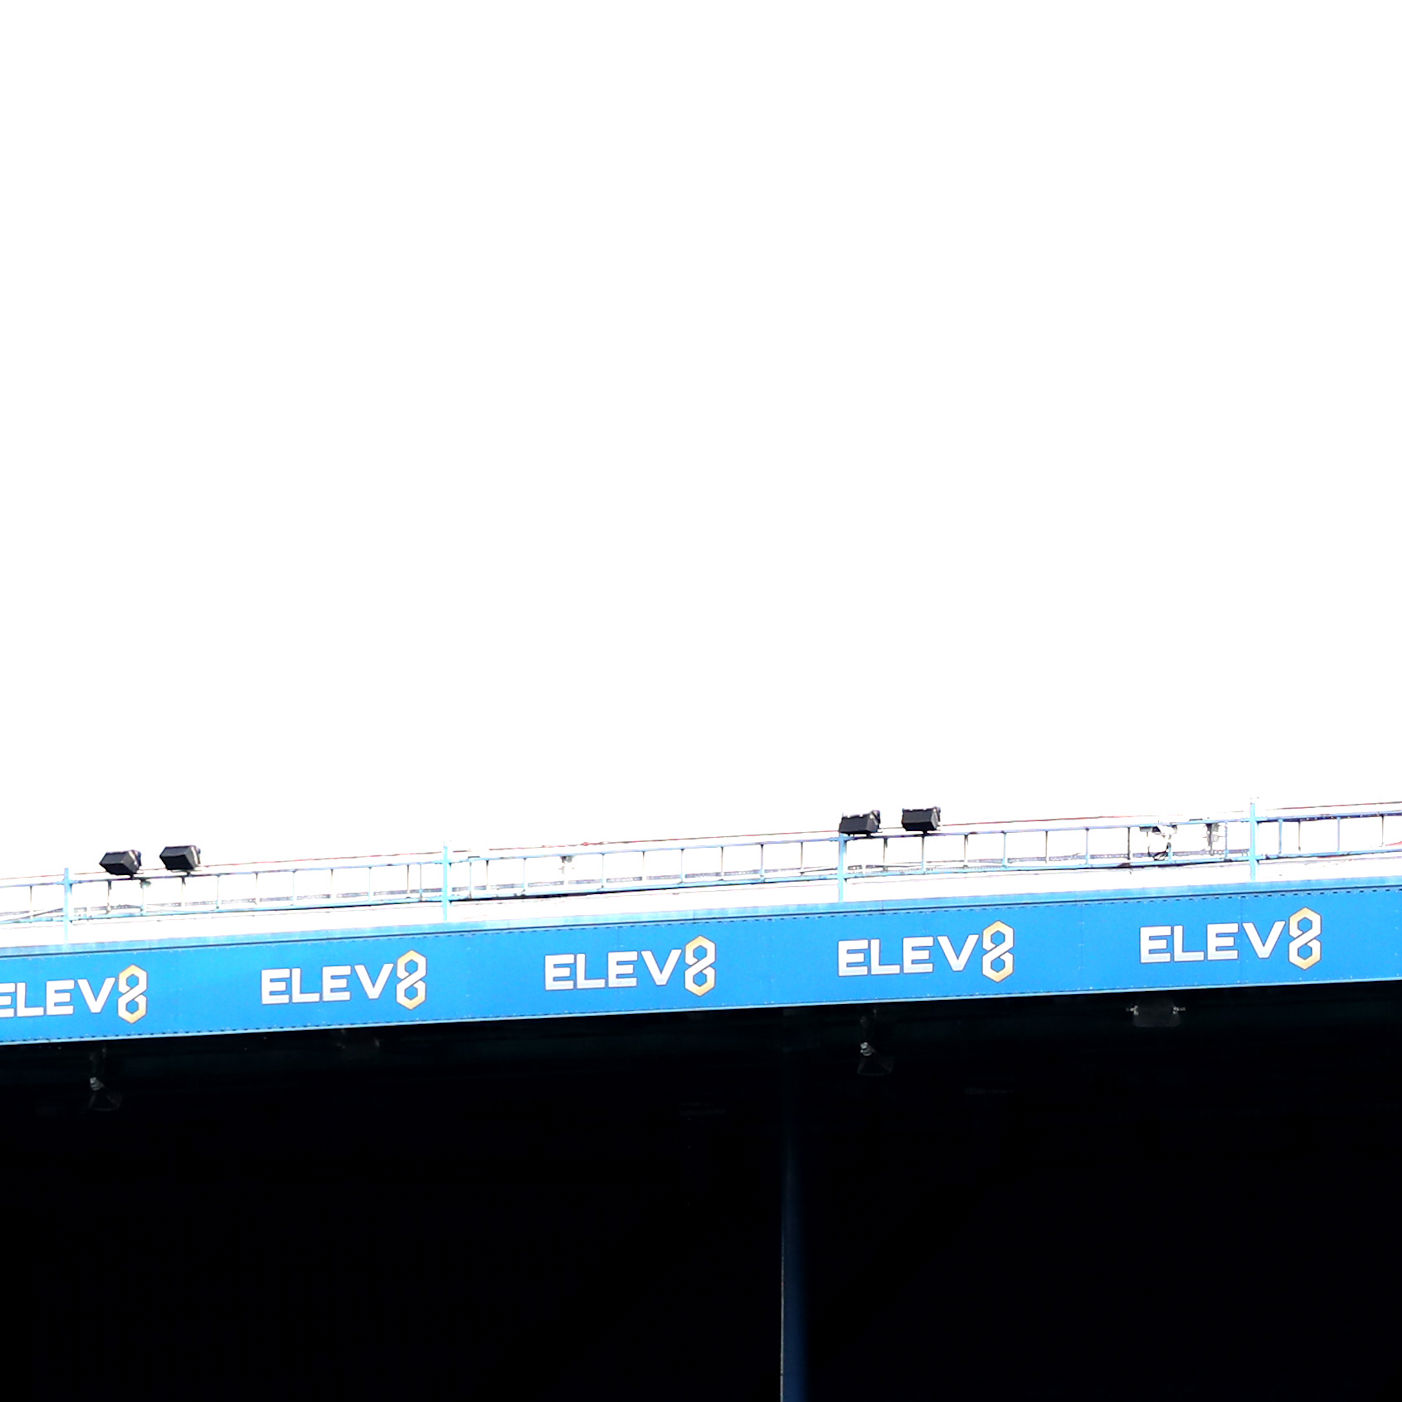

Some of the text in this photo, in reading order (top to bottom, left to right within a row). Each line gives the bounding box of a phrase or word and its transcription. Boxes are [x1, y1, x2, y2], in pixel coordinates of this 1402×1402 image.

[545, 936, 715, 996] ELEV8
[838, 921, 1014, 982] ELEV8
[1140, 907, 1321, 969] ELEV8
[261, 950, 426, 1010] ELEV8
